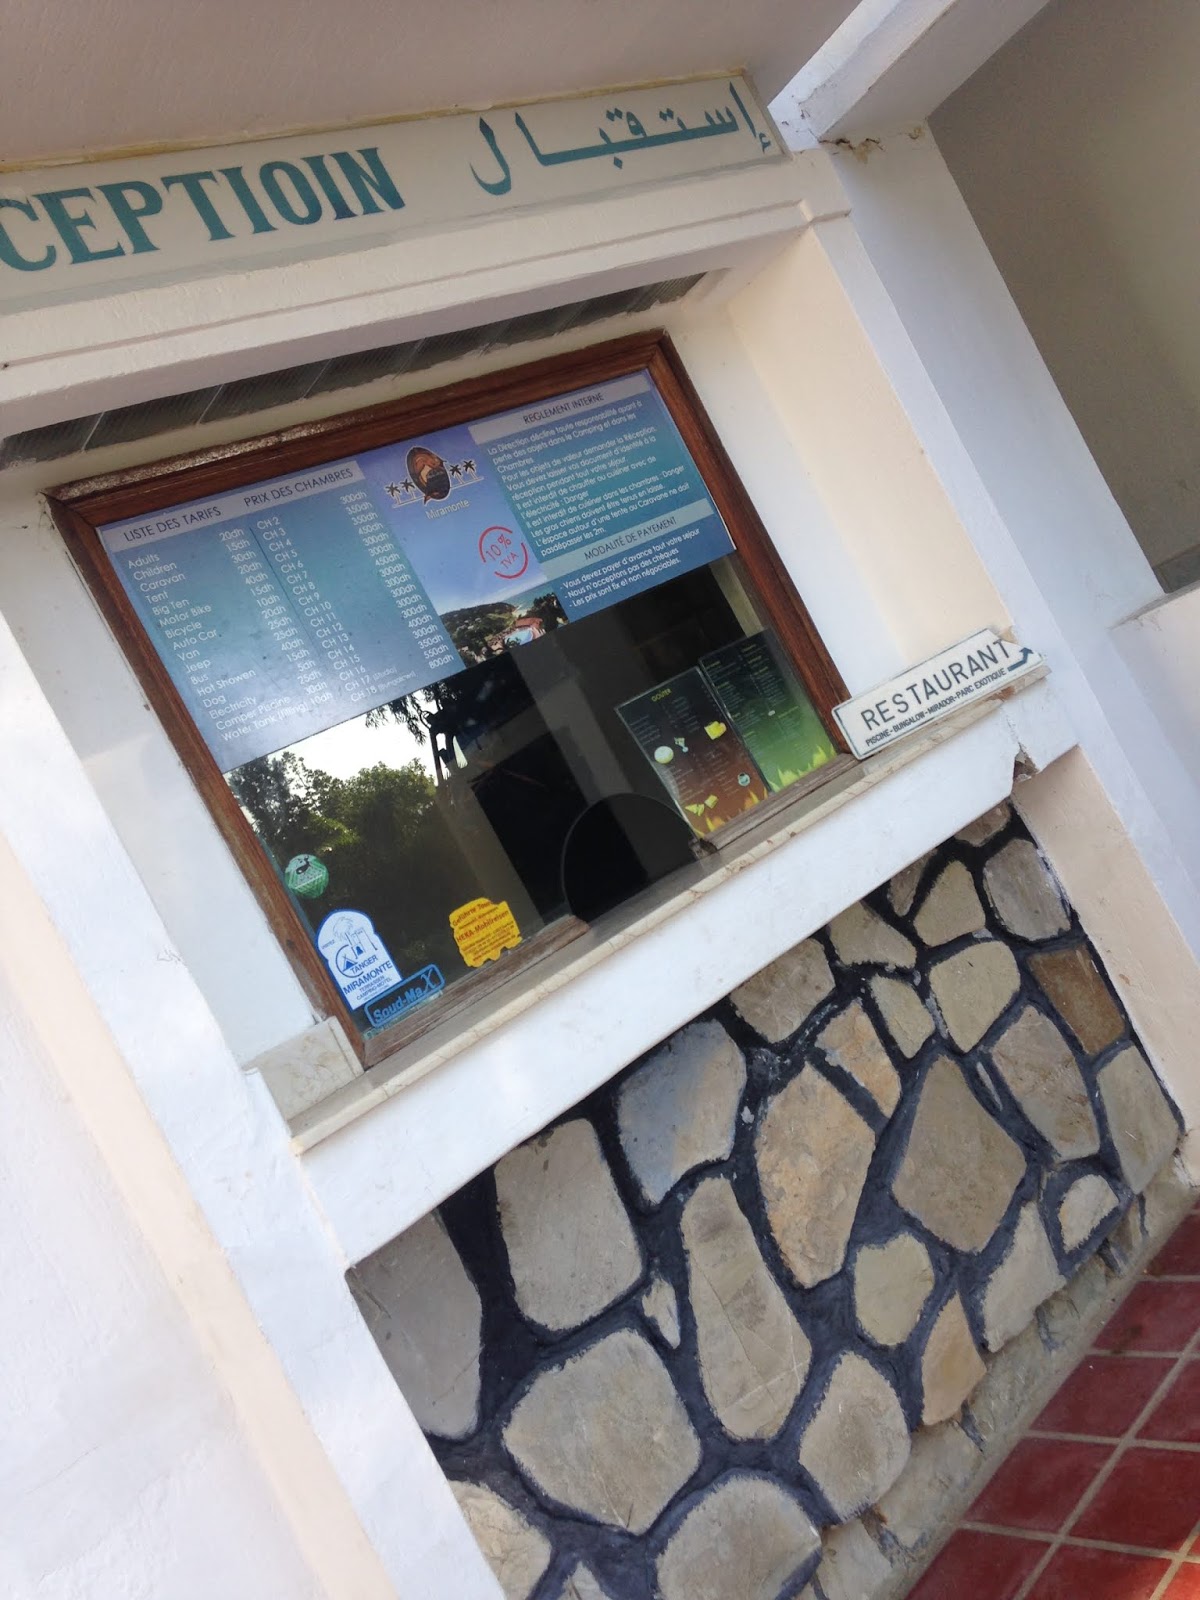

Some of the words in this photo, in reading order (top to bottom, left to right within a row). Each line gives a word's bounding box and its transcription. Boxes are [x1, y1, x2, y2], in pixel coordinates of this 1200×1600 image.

[571, 393, 604, 409] INTERNE
[244, 492, 270, 507] PRIX
[270, 486, 294, 500] DES
[293, 468, 354, 493] CHAMBRES
[340, 490, 367, 504] 300dh
[346, 501, 373, 515] 350dh
[425, 498, 471, 520] Miramonte
[123, 525, 155, 542] LISTE
[156, 518, 181, 533] DES
[182, 506, 222, 525] TARIFS
[256, 519, 273, 530] CH
[272, 517, 281, 525] 2
[351, 511, 378, 525] 350dh
[219, 527, 245, 541] 20dh
[262, 530, 278, 541] CH
[278, 527, 286, 536] 3
[357, 521, 384, 536] 450dh
[226, 539, 251, 552] 15dh
[268, 541, 285, 552] CH
[284, 538, 292, 547] 4
[363, 532, 389, 546] 300dh
[583, 536, 626, 560] MODALITÉ
[625, 533, 638, 543] DE
[637, 516, 678, 539] PAYEMENT
[274, 552, 291, 563] CH
[290, 549, 298, 558] 5
[369, 542, 395, 557] 300dh
[486, 544, 502, 561] 10
[127, 553, 161, 569] Adults
[280, 562, 296, 574] CH
[296, 560, 304, 568] 6
[374, 552, 401, 567] 450dh
[500, 552, 519, 570] TVA
[563, 577, 581, 590] Vous
[581, 569, 602, 582] devez
[602, 562, 623, 575] payer
[621, 548, 653, 566] d'avance
[653, 542, 666, 552] tout
[666, 536, 683, 547] votre
[133, 561, 177, 581] Children
[238, 561, 263, 575] 20dh
[379, 563, 406, 578] 300dh
[139, 571, 186, 593] Caravan
[244, 571, 269, 586] 40dh
[286, 573, 302, 585] CH
[302, 571, 309, 579] 7
[385, 573, 412, 588] 300dh
[567, 586, 586, 598] Nous
[585, 569, 628, 592] n'acceptons
[627, 565, 641, 575] pas
[639, 558, 652, 568] des
[250, 582, 275, 597] 15dh
[292, 584, 308, 595] CH
[308, 581, 316, 590] 8
[390, 583, 417, 598] 300dh
[572, 597, 585, 607] Les
[584, 592, 598, 603] prix
[597, 586, 612, 597] sont
[611, 582, 620, 590] fix
[620, 579, 628, 587] et
[628, 574, 642, 583] non
[146, 590, 169, 604] Tent
[257, 593, 281, 608] 10dh
[298, 595, 313, 606] CH
[314, 592, 321, 601] 9
[396, 593, 422, 608] 300dh
[152, 604, 171, 618] Big
[159, 611, 191, 628] Motor
[191, 604, 212, 617] Bike
[261, 604, 287, 619] 20dh
[304, 606, 320, 617] CH
[320, 601, 332, 611] 10
[401, 603, 428, 618] 300dh
[267, 615, 293, 630] 25dh
[310, 616, 325, 628] CH
[326, 612, 337, 622] 11
[407, 613, 433, 629] 400dh
[165, 620, 203, 640] Bicycle
[274, 626, 299, 641] 25dh
[315, 627, 331, 639] CH
[332, 622, 344, 632] 12
[412, 623, 438, 639] 300dh
[171, 636, 198, 651] Auto
[198, 628, 218, 641] Car
[280, 637, 305, 652] 40dh
[321, 638, 337, 649] CH
[338, 633, 349, 643] 13
[418, 633, 444, 649] 350dh
[178, 648, 200, 662] Van
[286, 648, 310, 663] 15dh
[327, 649, 343, 660] CH
[344, 644, 355, 654] 14
[423, 643, 449, 659] 550dh
[184, 658, 213, 675] Jeep
[297, 659, 316, 672] 5dh
[333, 659, 348, 671] CH
[349, 654, 361, 664] 15
[428, 653, 455, 670] 800dh
[191, 672, 209, 685] Bus
[297, 669, 322, 685] 25dh
[338, 669, 354, 682] CH
[355, 664, 367, 675] 16
[974, 667, 1007, 689] EXOTIQUE
[197, 684, 216, 697] Hot
[344, 680, 360, 692] CH
[360, 675, 372, 685] 17
[860, 639, 1011, 731] RESTAURANT
[203, 693, 227, 710] Dog
[310, 690, 334, 706] 10dh
[350, 690, 366, 703] CH
[366, 685, 378, 696] 18
[209, 695, 258, 721] Electricity
[222, 724, 253, 742] Water
[253, 714, 277, 729] Tank
[350, 954, 379, 976] TANGER
[342, 960, 394, 995] MIRAMONTE
